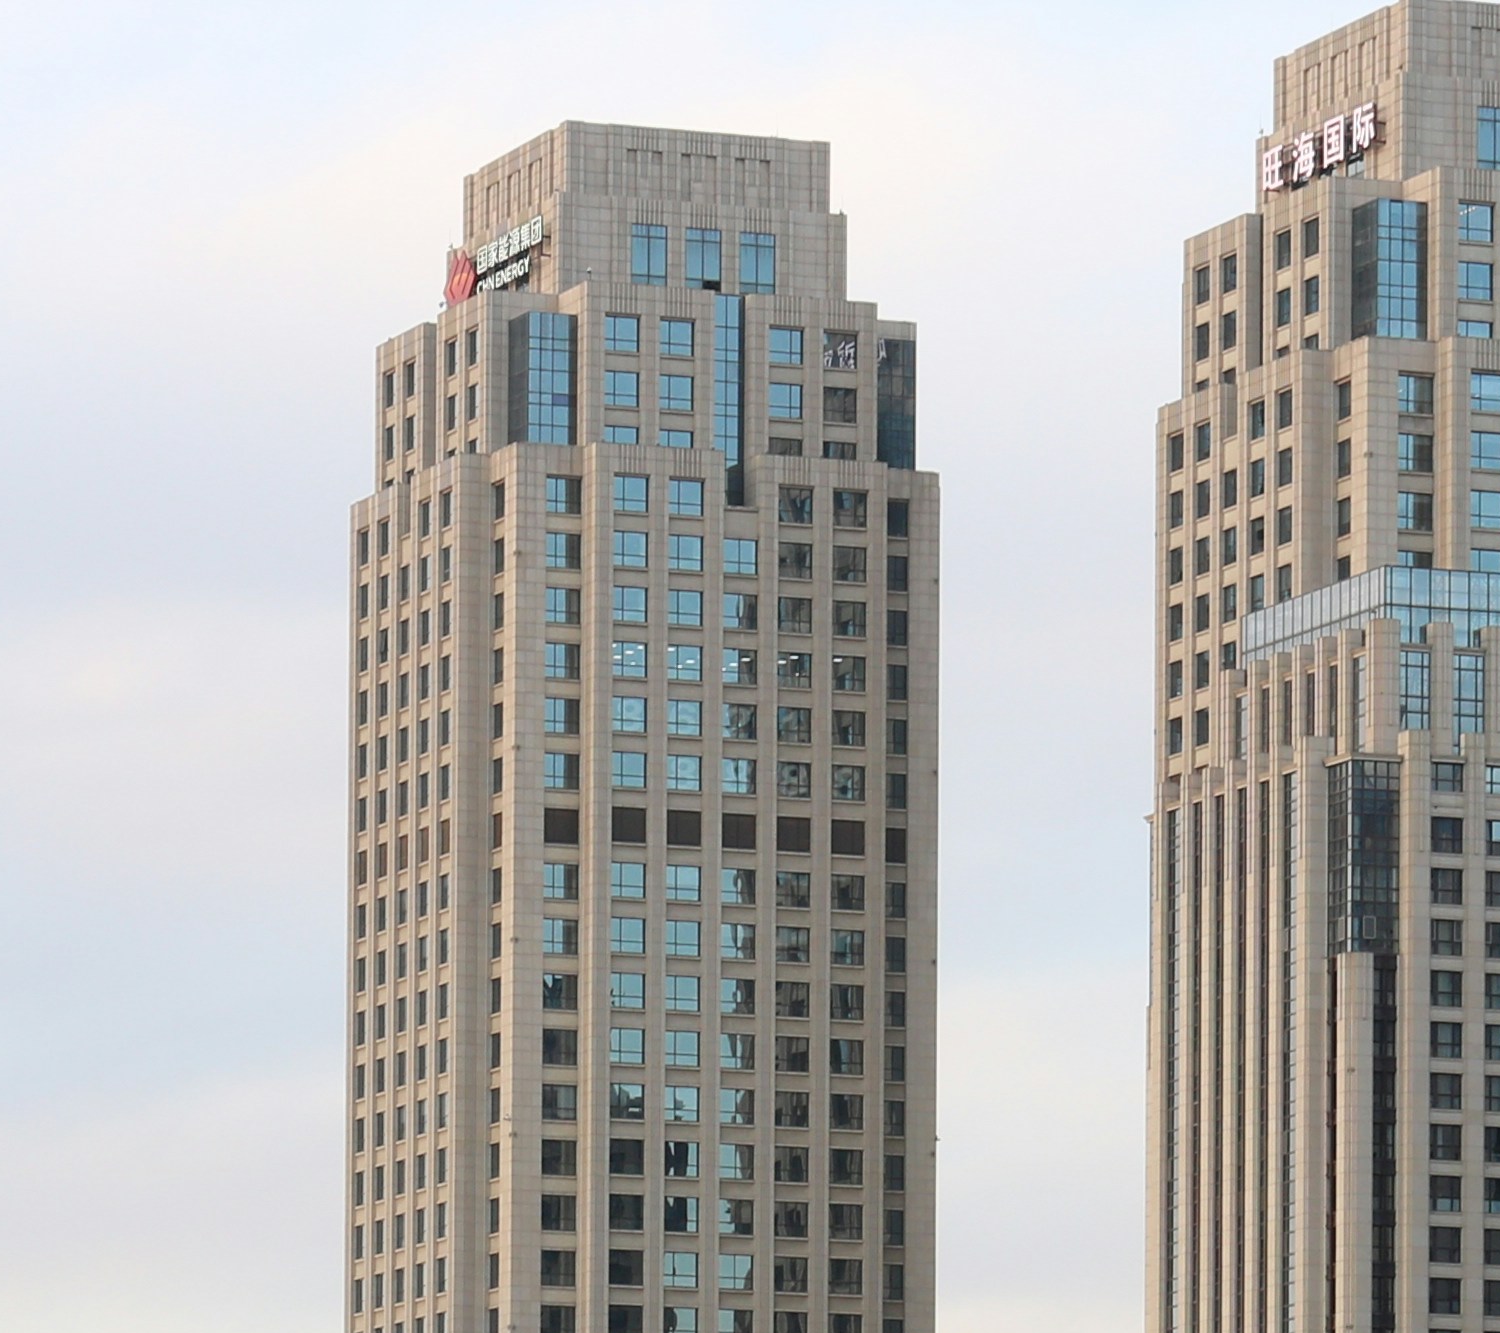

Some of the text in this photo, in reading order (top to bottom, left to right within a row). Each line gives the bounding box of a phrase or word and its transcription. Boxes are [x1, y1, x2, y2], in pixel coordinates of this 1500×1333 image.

[1262, 100, 1376, 191] 旺海国际
[476, 215, 542, 275] 国家能源集团
[476, 255, 531, 294] CHN ENERGY
